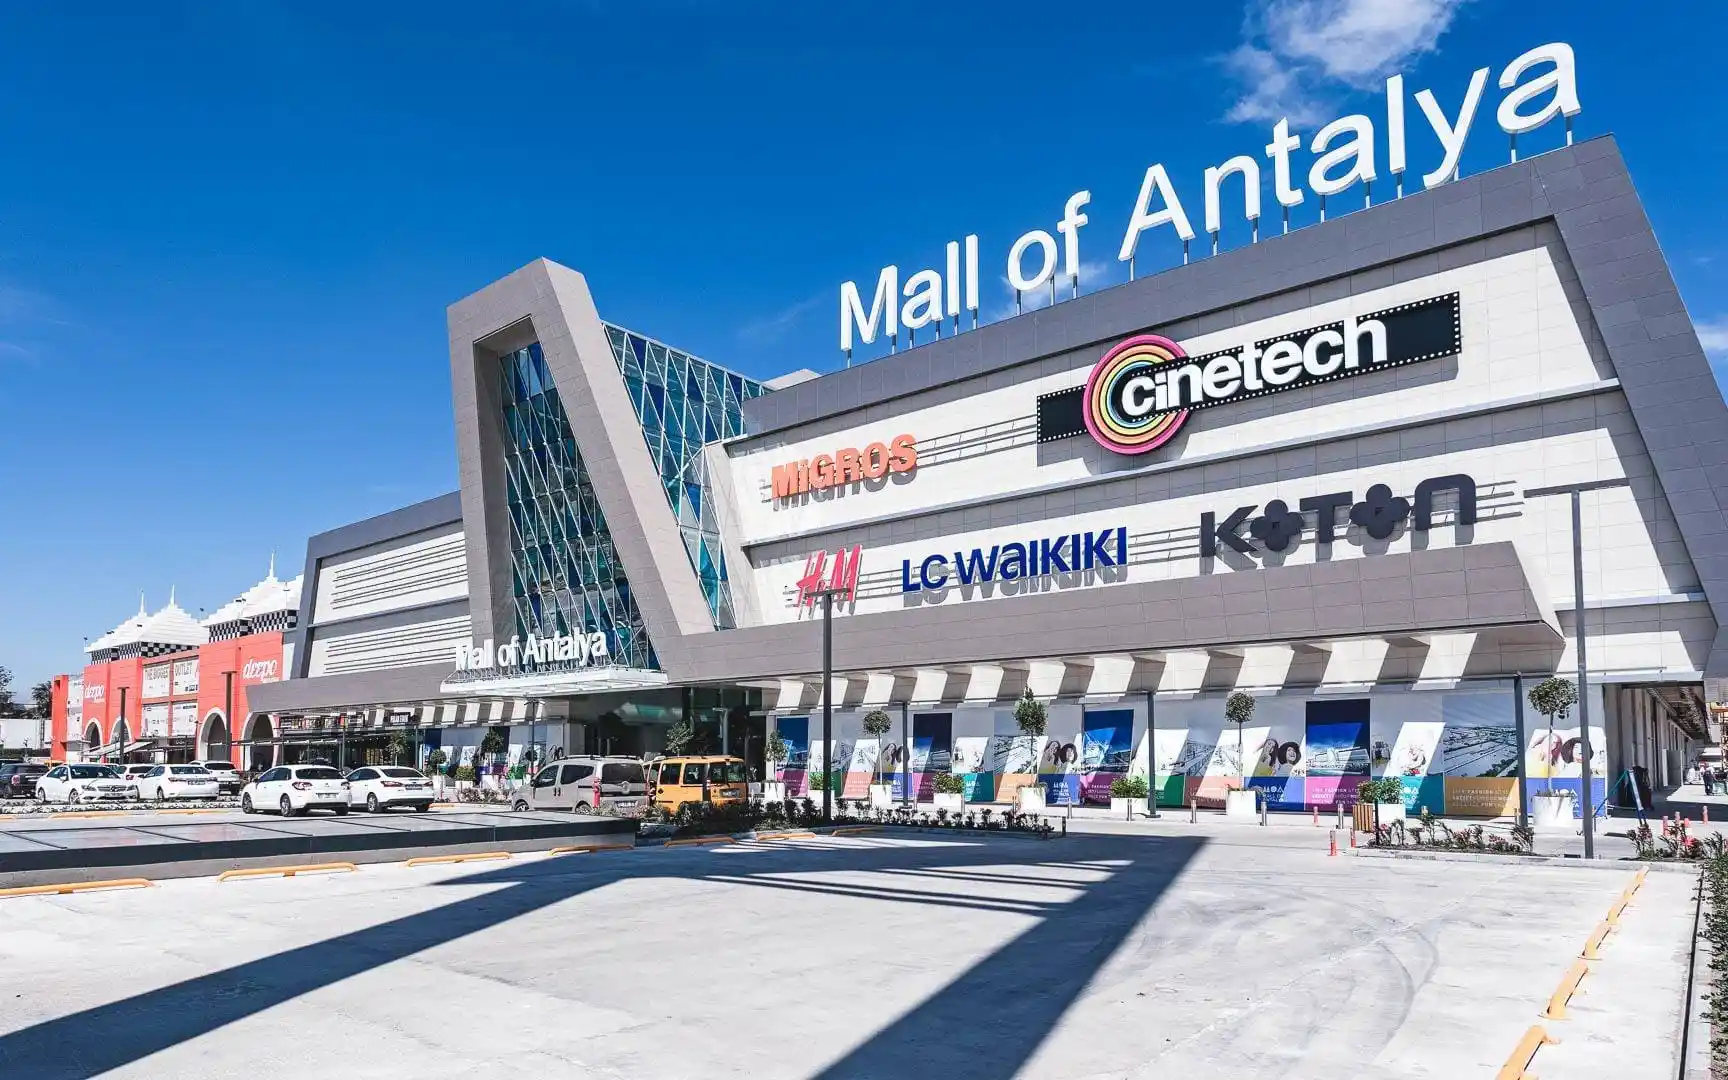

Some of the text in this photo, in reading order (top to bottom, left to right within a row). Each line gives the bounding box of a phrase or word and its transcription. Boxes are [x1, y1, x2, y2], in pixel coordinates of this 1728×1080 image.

[839, 41, 1582, 351] Mall of Antalya
[1121, 315, 1388, 417] cinetech
[902, 553, 949, 593] LC
[455, 626, 607, 671] Mall of Antalya
